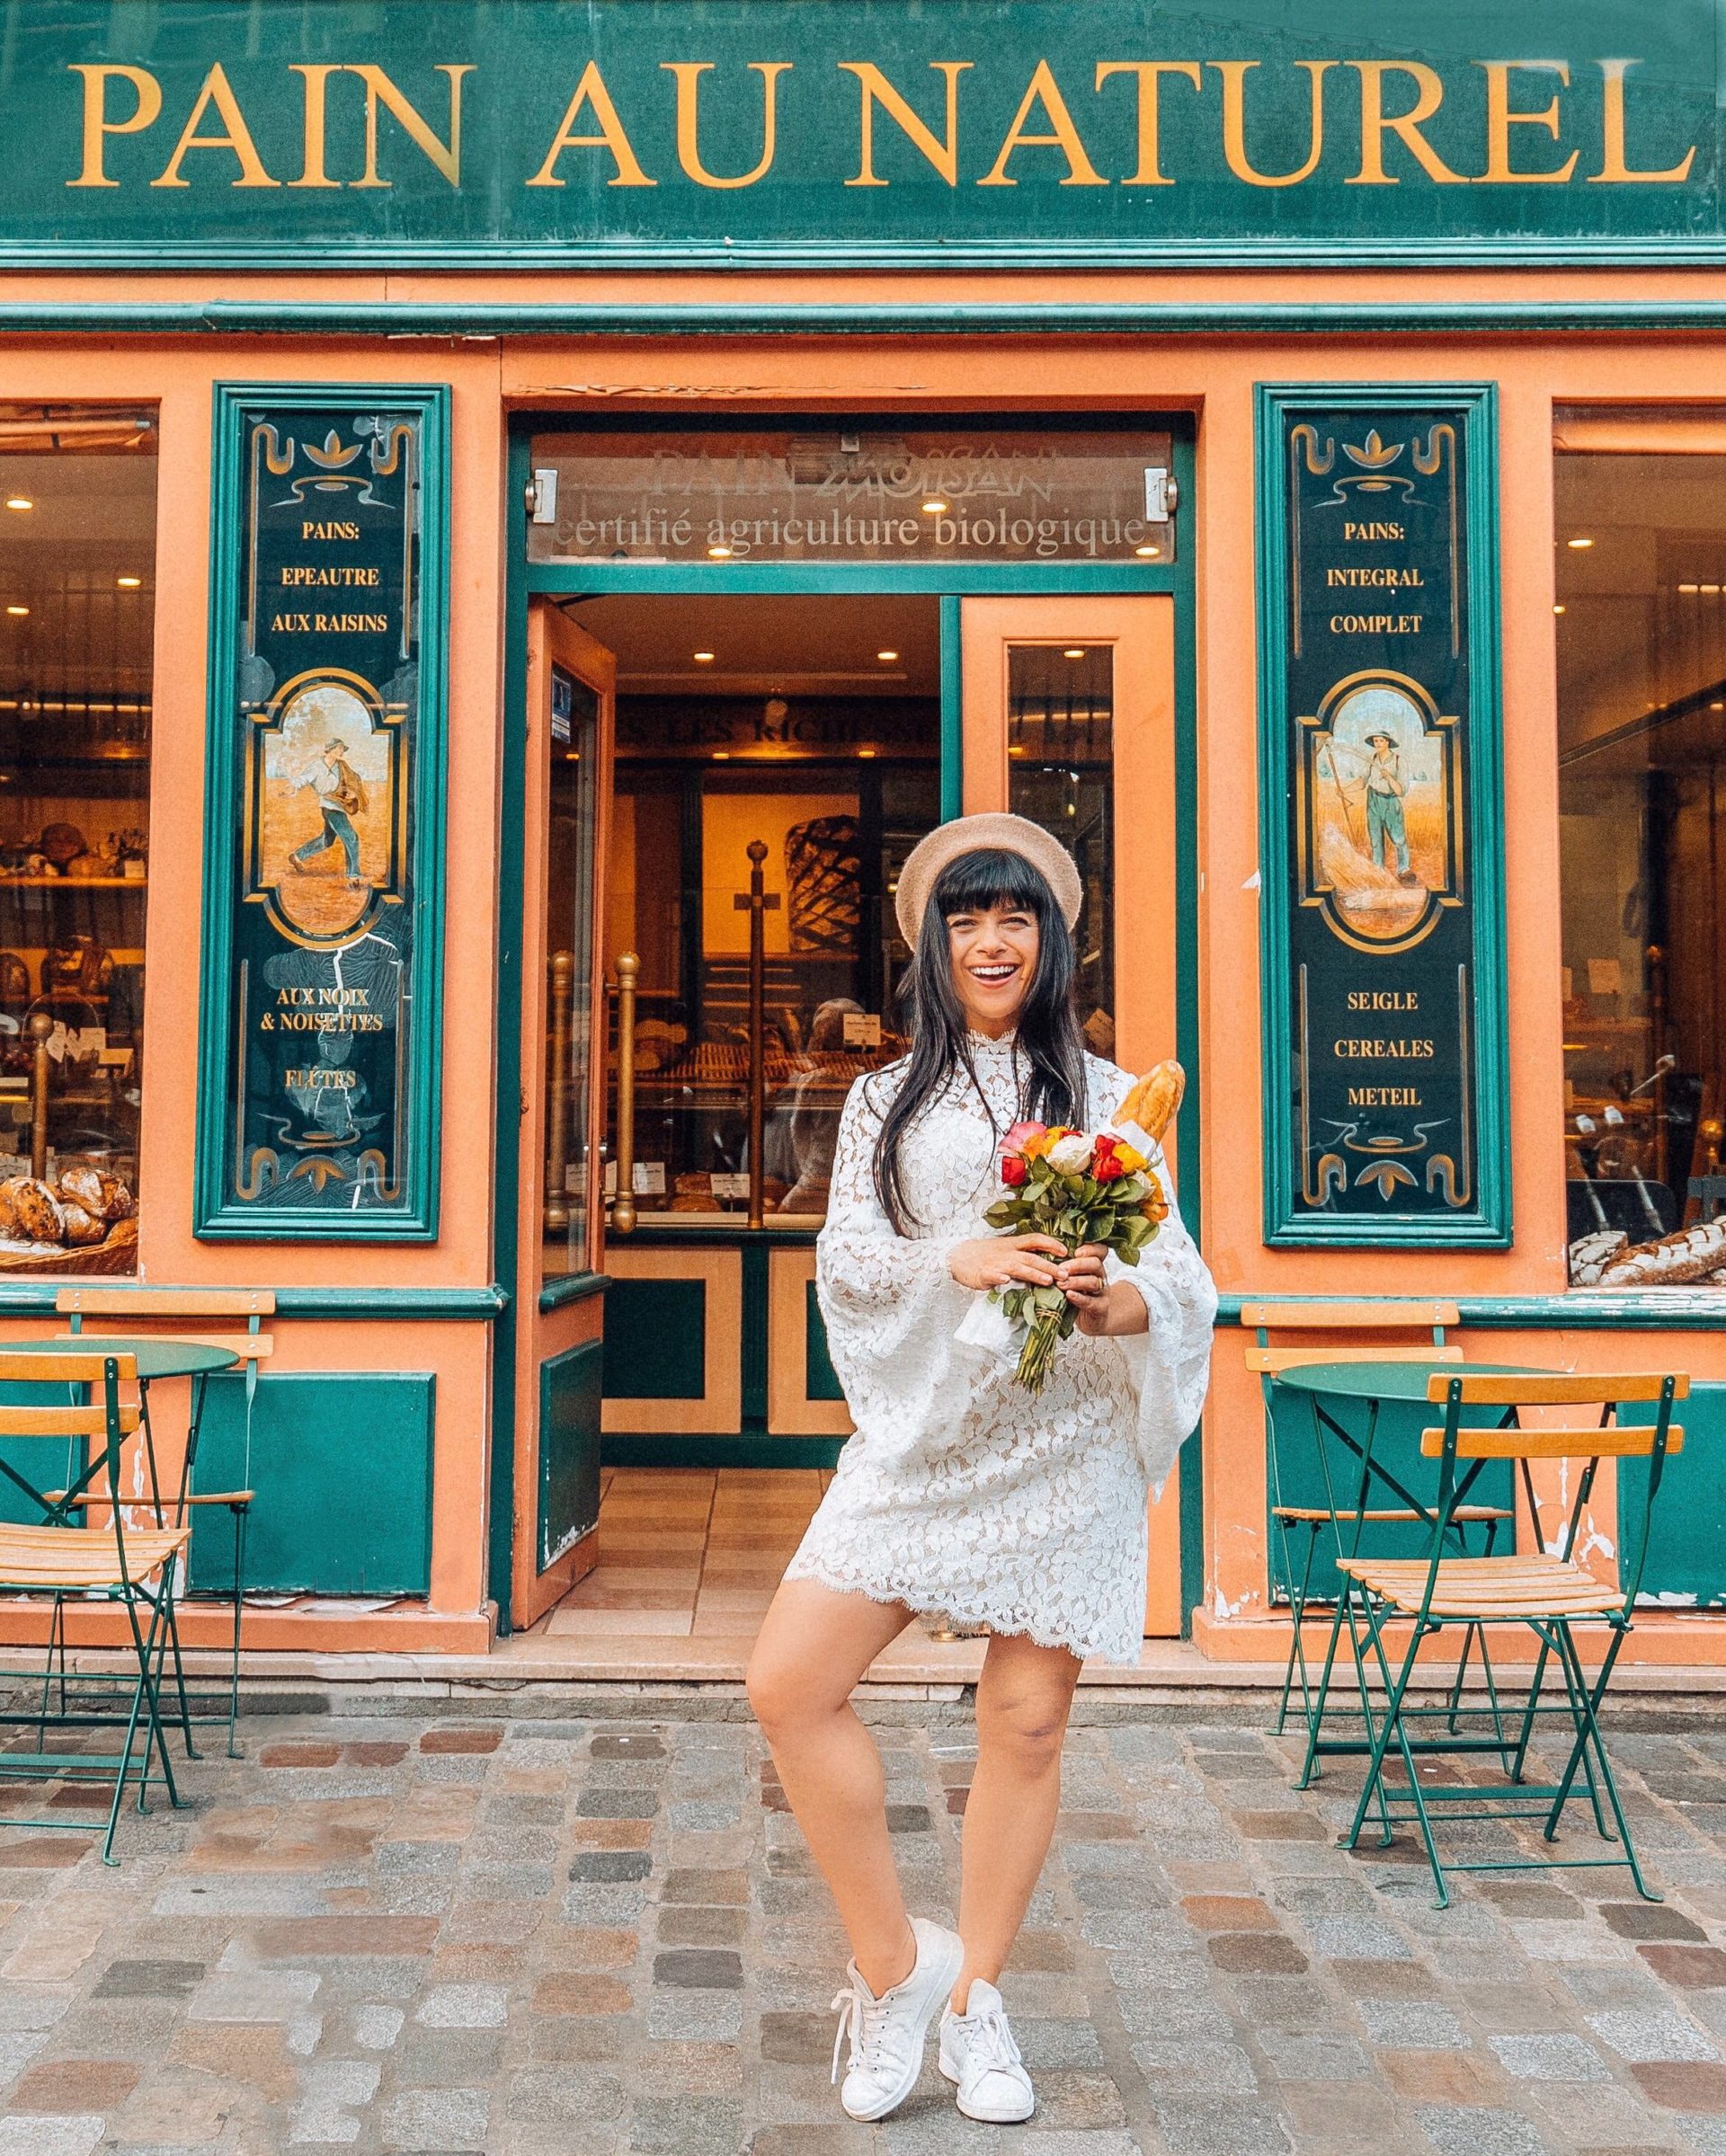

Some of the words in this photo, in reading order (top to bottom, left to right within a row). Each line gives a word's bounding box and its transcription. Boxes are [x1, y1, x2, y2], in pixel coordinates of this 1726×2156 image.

[66, 61, 478, 189] PAIN
[525, 60, 793, 189] AU
[838, 58, 1697, 188] NATUREL
[302, 521, 360, 540] PAINS:
[554, 507, 692, 547] certifié
[707, 509, 919, 556] agriculture
[932, 507, 1145, 557] biologique
[1343, 522, 1405, 541] PAINS:
[280, 567, 379, 587] EPEAUTRE
[1326, 568, 1425, 587] INTEGRAL
[271, 614, 311, 633] AUX
[315, 614, 387, 633] RAISINS
[1330, 615, 1423, 634] COMPLET
[276, 987, 316, 1006] AUX
[318, 987, 370, 1007] NOIX
[1347, 991, 1419, 1011] SEIGLE
[260, 1012, 275, 1031] &
[280, 1012, 384, 1033] NOISETTES
[1333, 1039, 1435, 1059] CEREALES
[1347, 1087, 1423, 1107] METEIL
